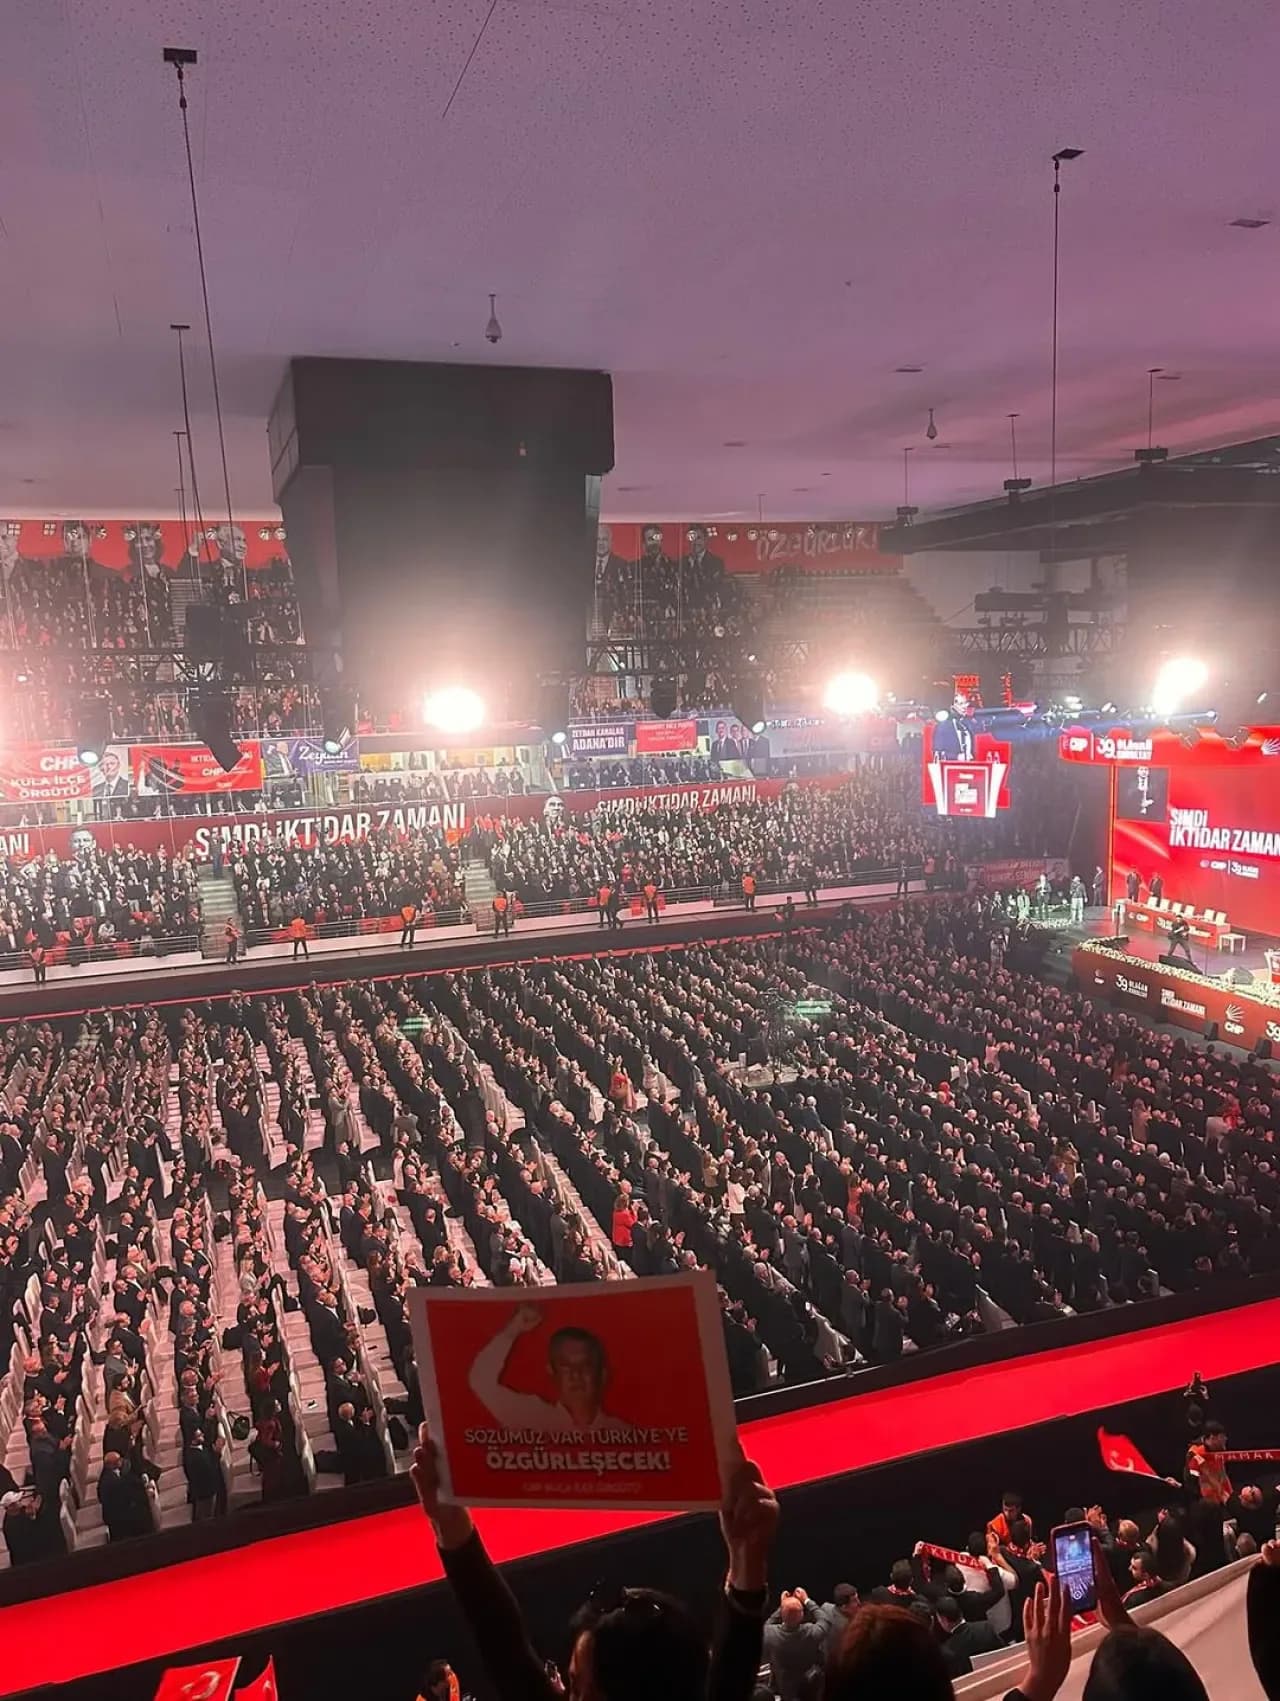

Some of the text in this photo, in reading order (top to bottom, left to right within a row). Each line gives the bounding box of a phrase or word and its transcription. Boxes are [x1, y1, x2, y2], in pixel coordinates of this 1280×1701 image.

[702, 784, 756, 807] ZAMANI
[549, 1429, 584, 1444] VAR
[486, 1445, 671, 1476] ÖZGÜRLEŞECEK!
